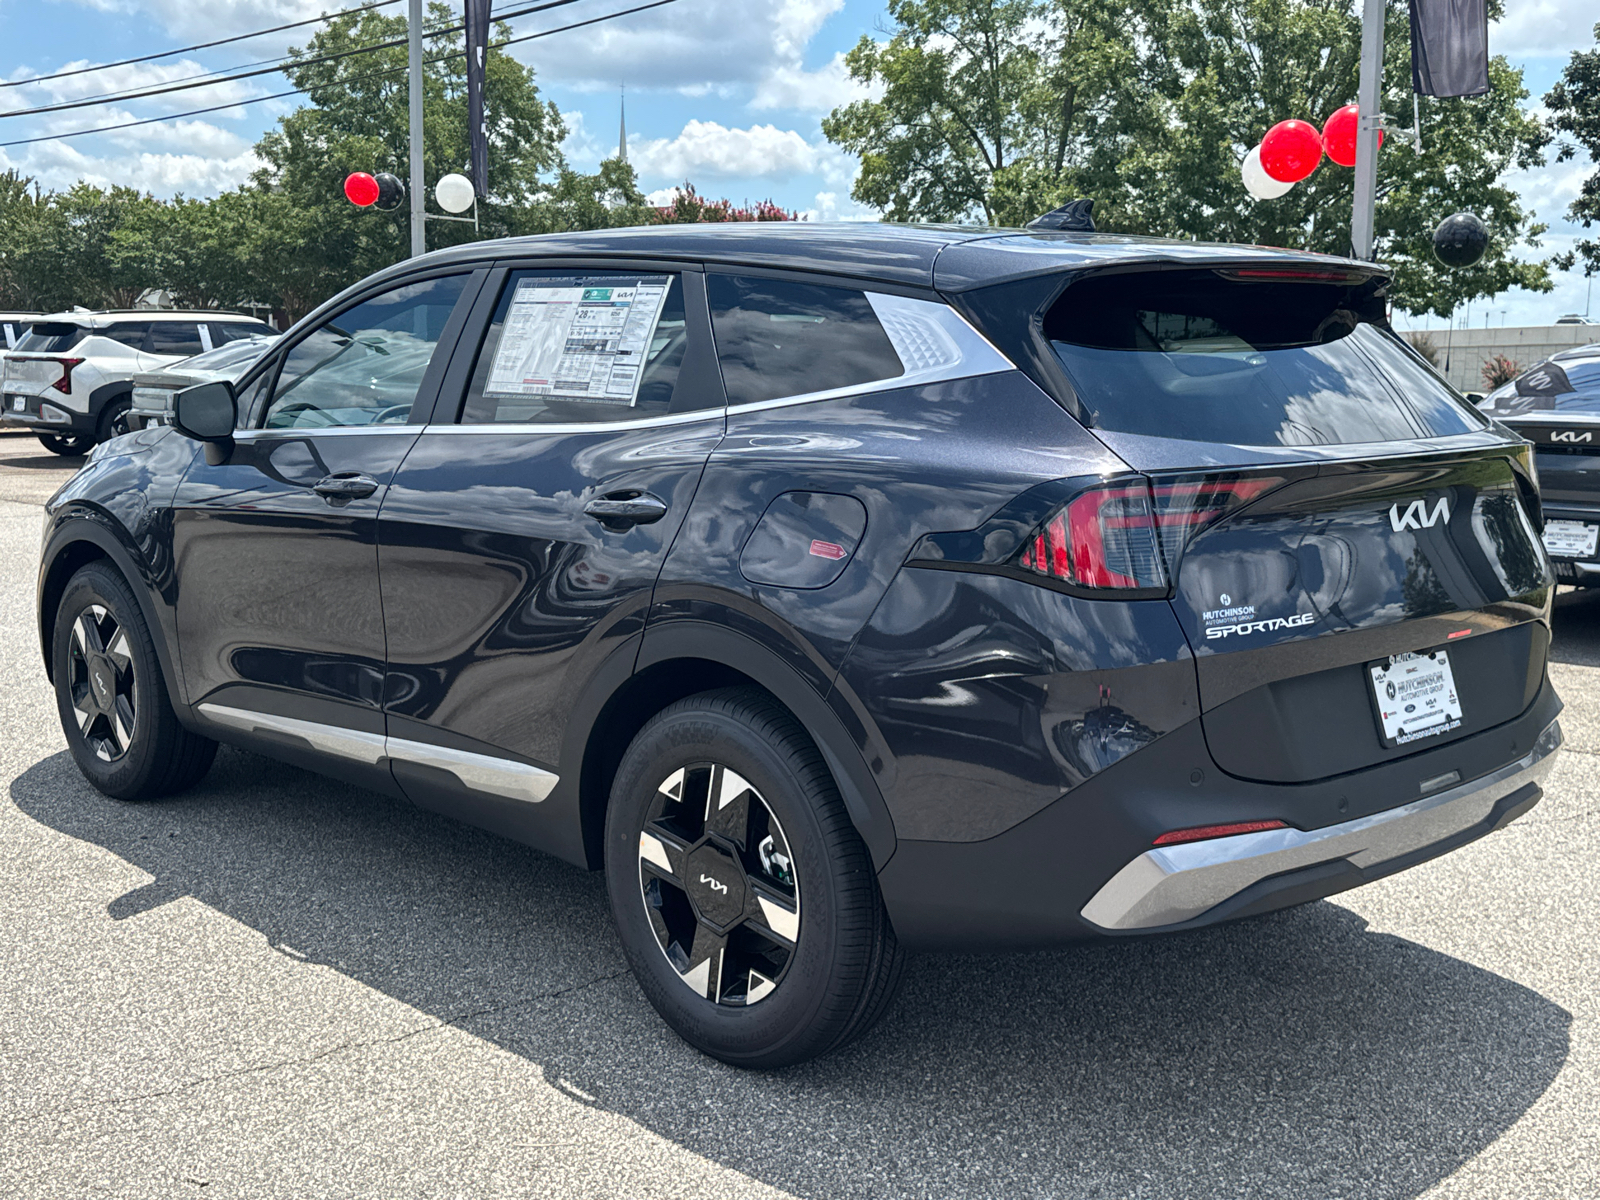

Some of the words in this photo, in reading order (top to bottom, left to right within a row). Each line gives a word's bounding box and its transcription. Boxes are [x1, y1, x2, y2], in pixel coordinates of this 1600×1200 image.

[1550, 431, 1592, 443] KIA
[1389, 497, 1450, 532] KIA
[1202, 606, 1255, 620] HUTCHINSON
[1205, 616, 1238, 626] AUTOMOTIVE
[1205, 613, 1315, 639] SPORTAGE
[1397, 671, 1445, 694] HUTCHINSON
[1401, 688, 1429, 702] AUTOMOTIVE
[1429, 683, 1444, 696] GROUP
[700, 873, 727, 895] KIA
